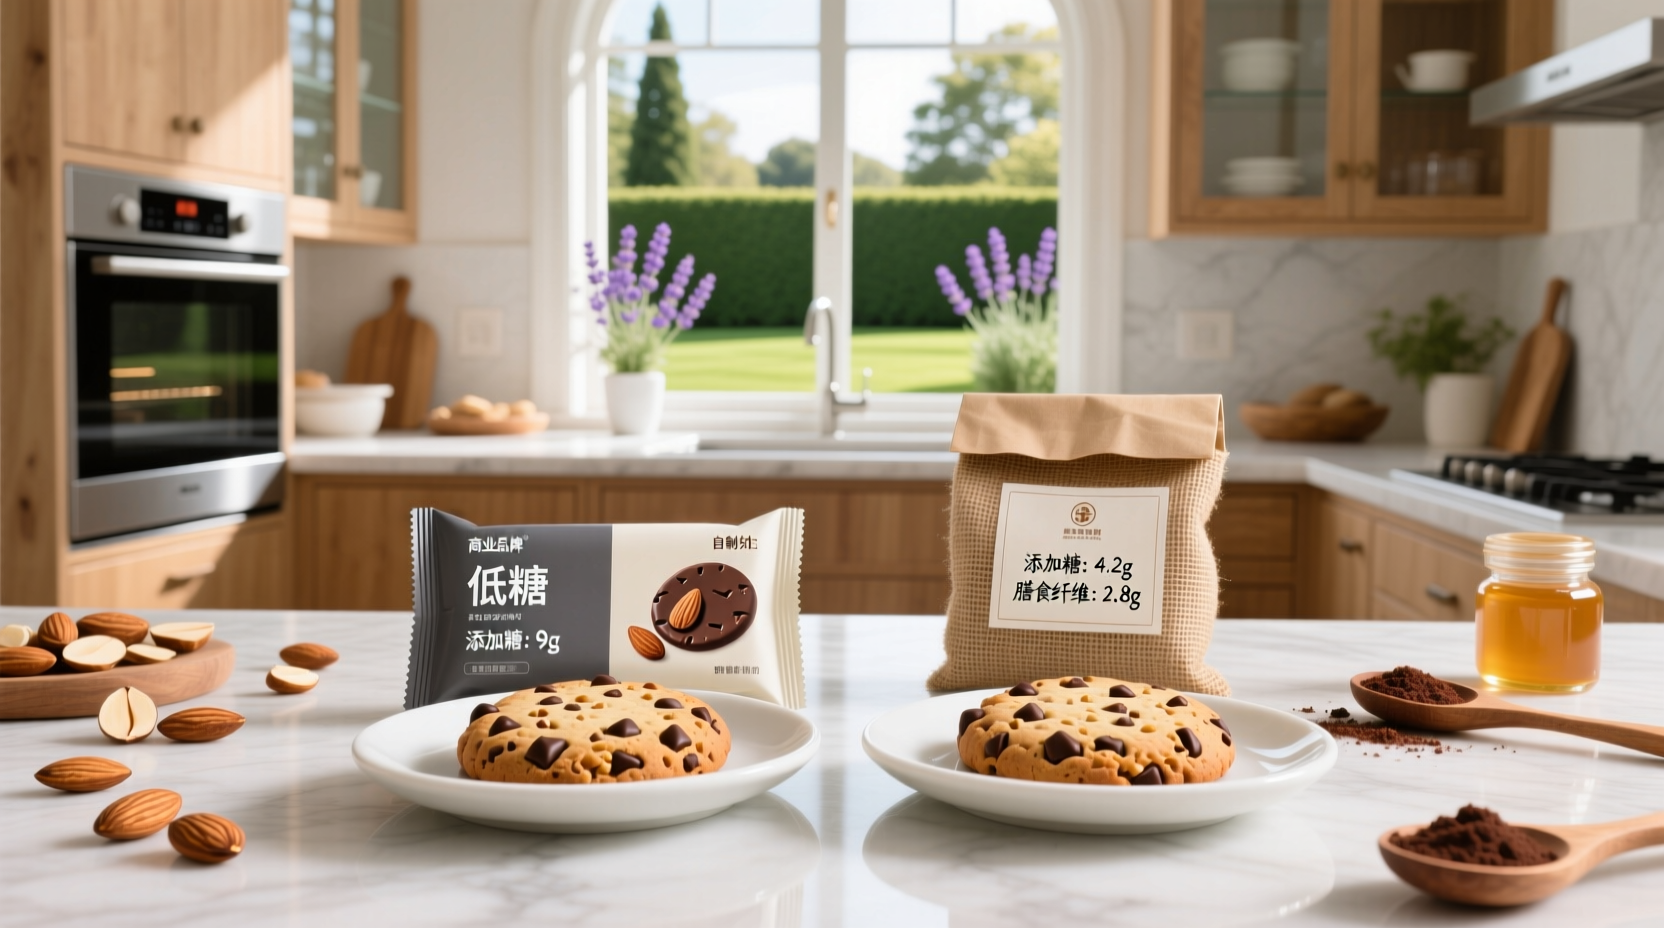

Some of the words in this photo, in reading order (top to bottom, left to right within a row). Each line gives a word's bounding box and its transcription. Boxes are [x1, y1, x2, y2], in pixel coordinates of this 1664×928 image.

[1094, 556, 1133, 581] 4.2g
[467, 565, 549, 607] 低糖
[1102, 584, 1141, 610] 2.8g
[535, 629, 561, 655] 9g
